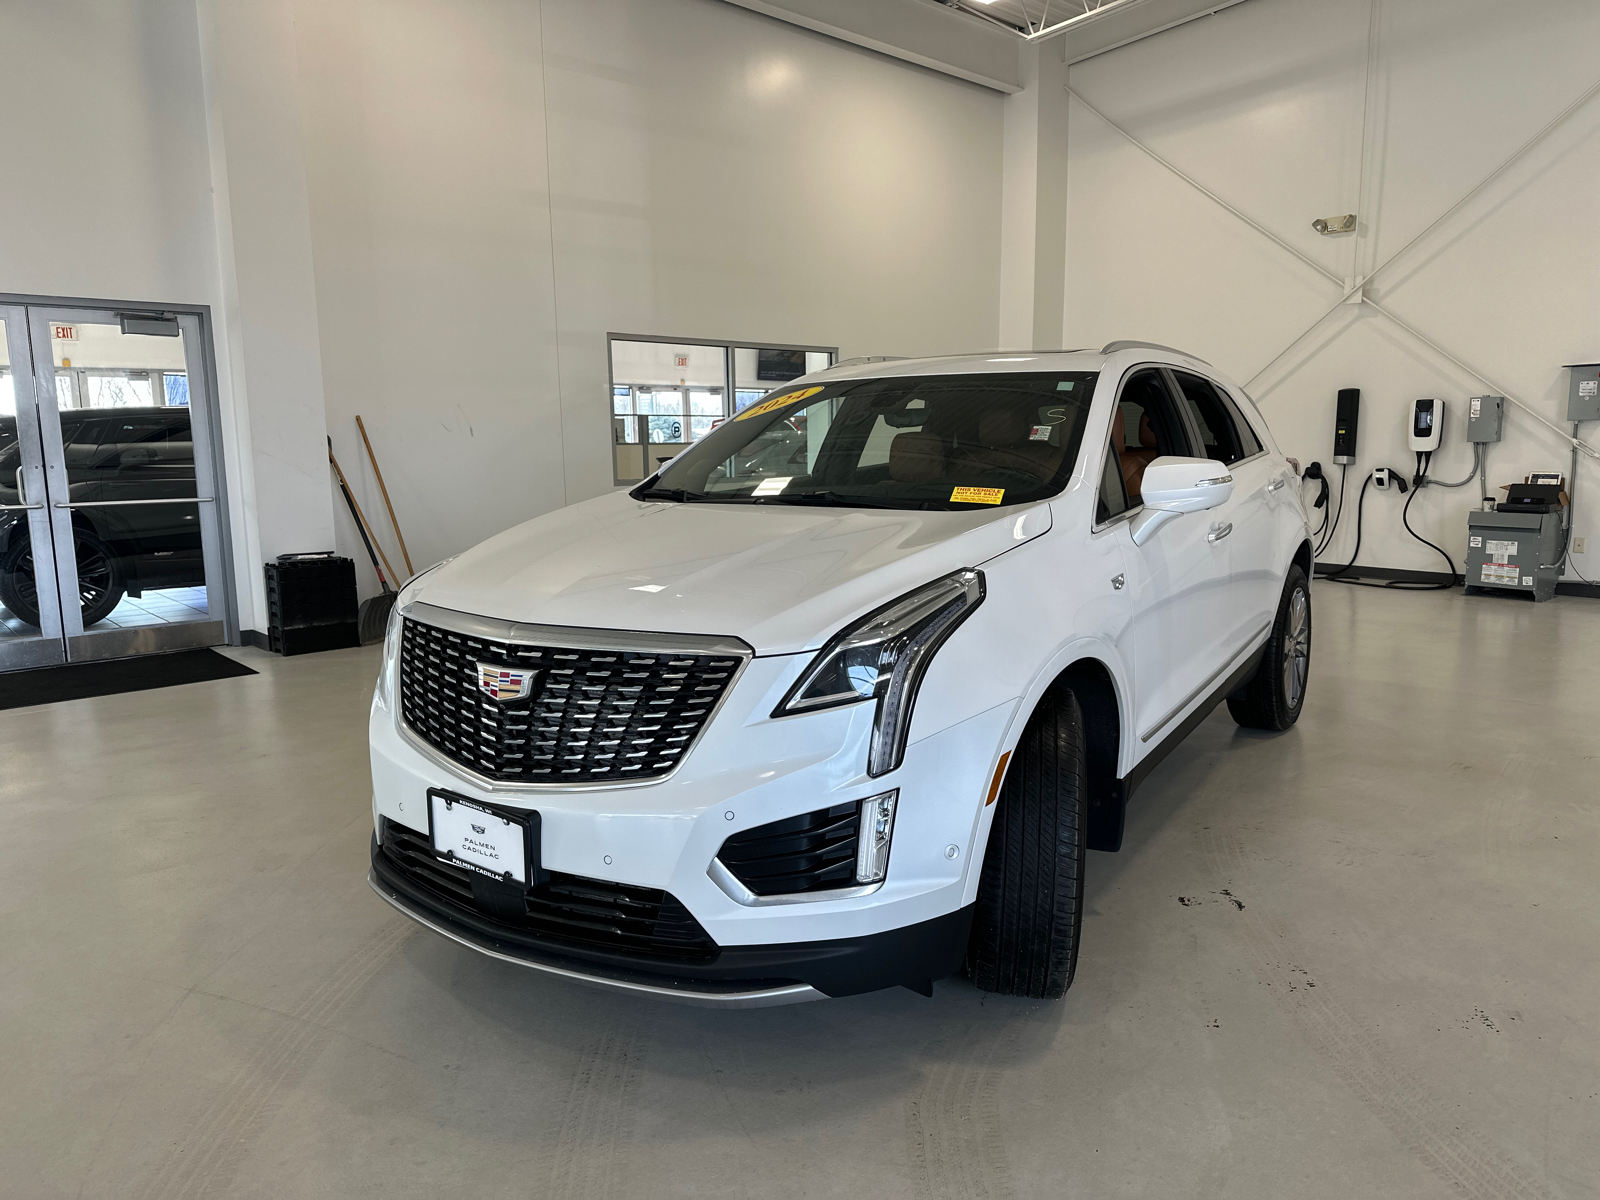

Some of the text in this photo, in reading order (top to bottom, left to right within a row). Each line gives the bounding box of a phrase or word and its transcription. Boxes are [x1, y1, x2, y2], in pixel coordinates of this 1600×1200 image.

[56, 326, 73, 339] EXIT
[748, 389, 809, 417] 2024
[462, 844, 499, 860] CADILLAC
[464, 837, 496, 851] PALMEN
[452, 858, 504, 882] PALMEN CADILLAC
